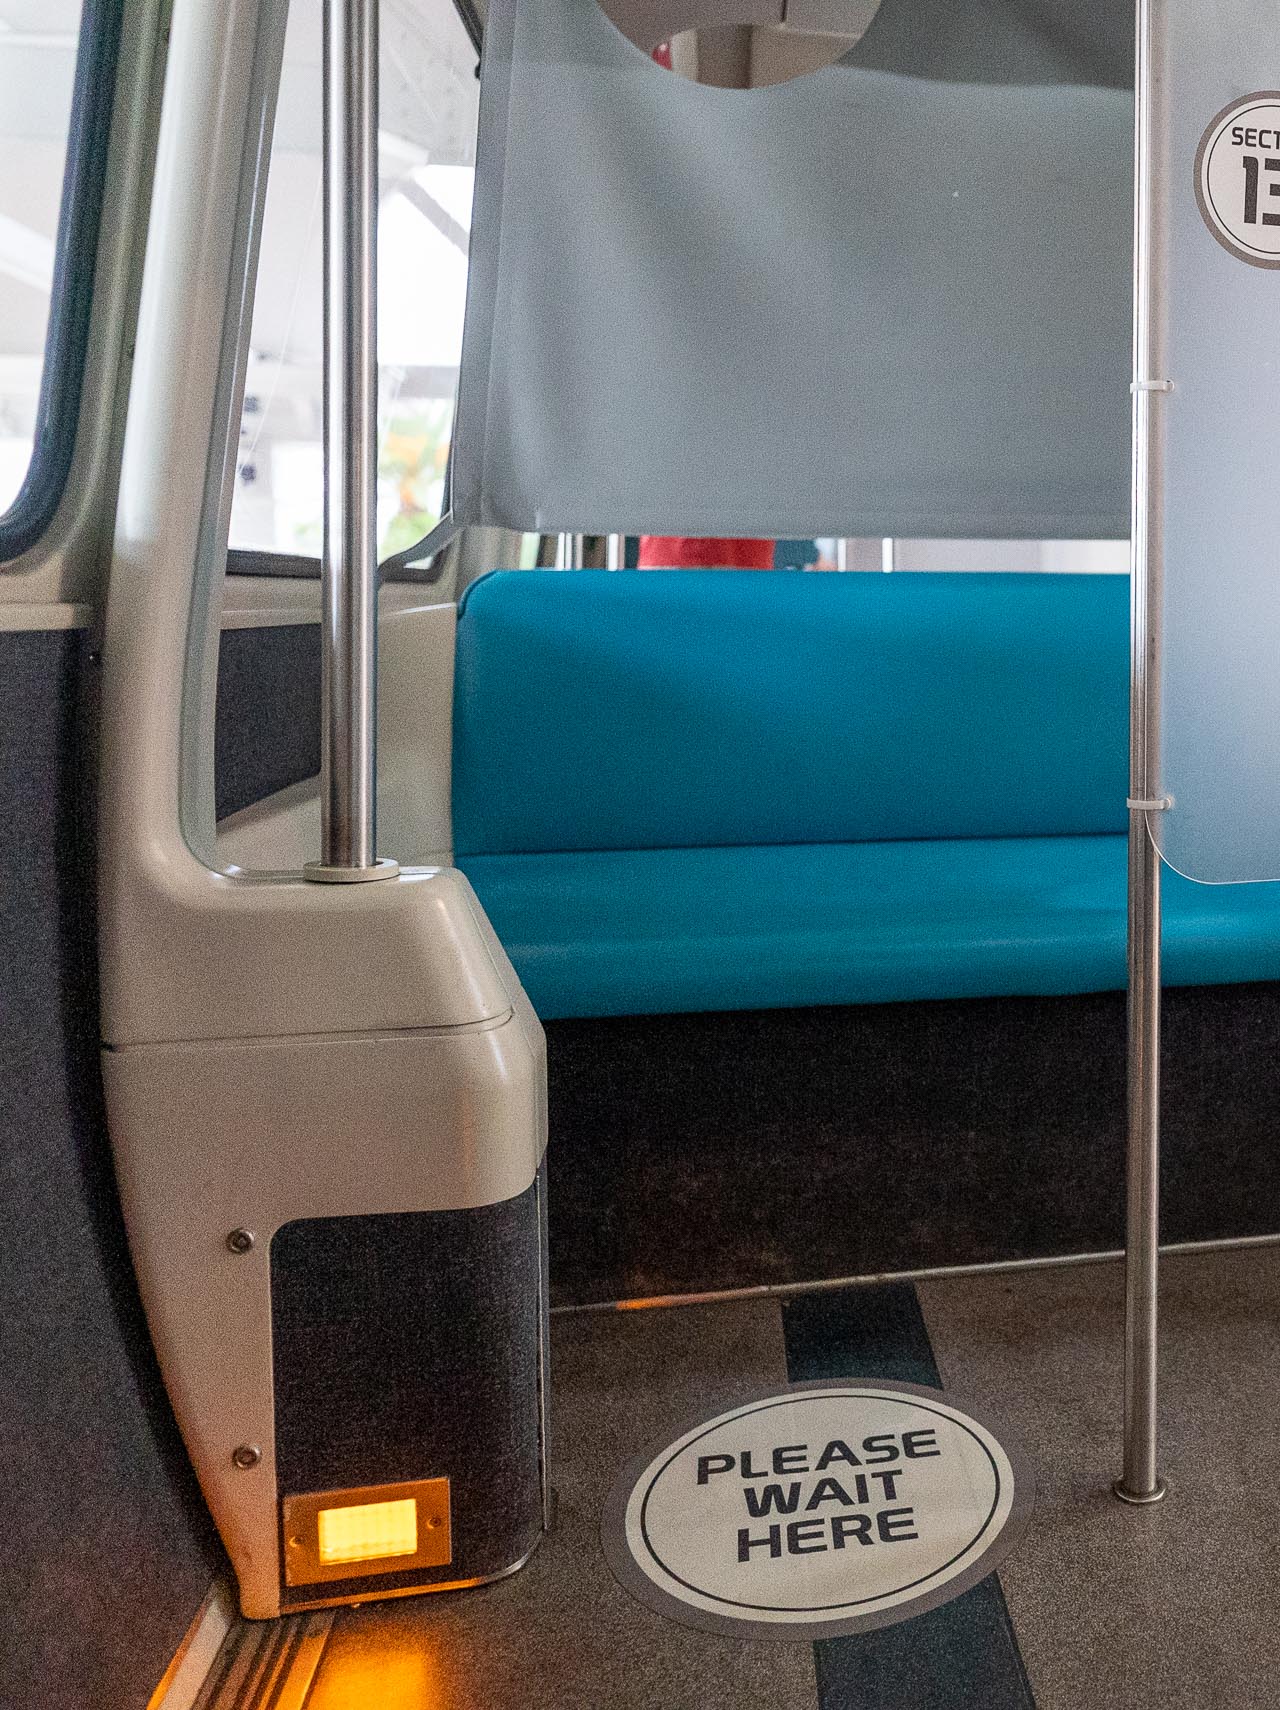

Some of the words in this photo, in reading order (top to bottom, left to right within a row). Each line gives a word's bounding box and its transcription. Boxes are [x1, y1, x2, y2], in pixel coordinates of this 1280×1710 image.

[696, 1428, 941, 1485] PLEASE
[743, 1469, 903, 1519] WAIT
[737, 1507, 919, 1563] HERE
